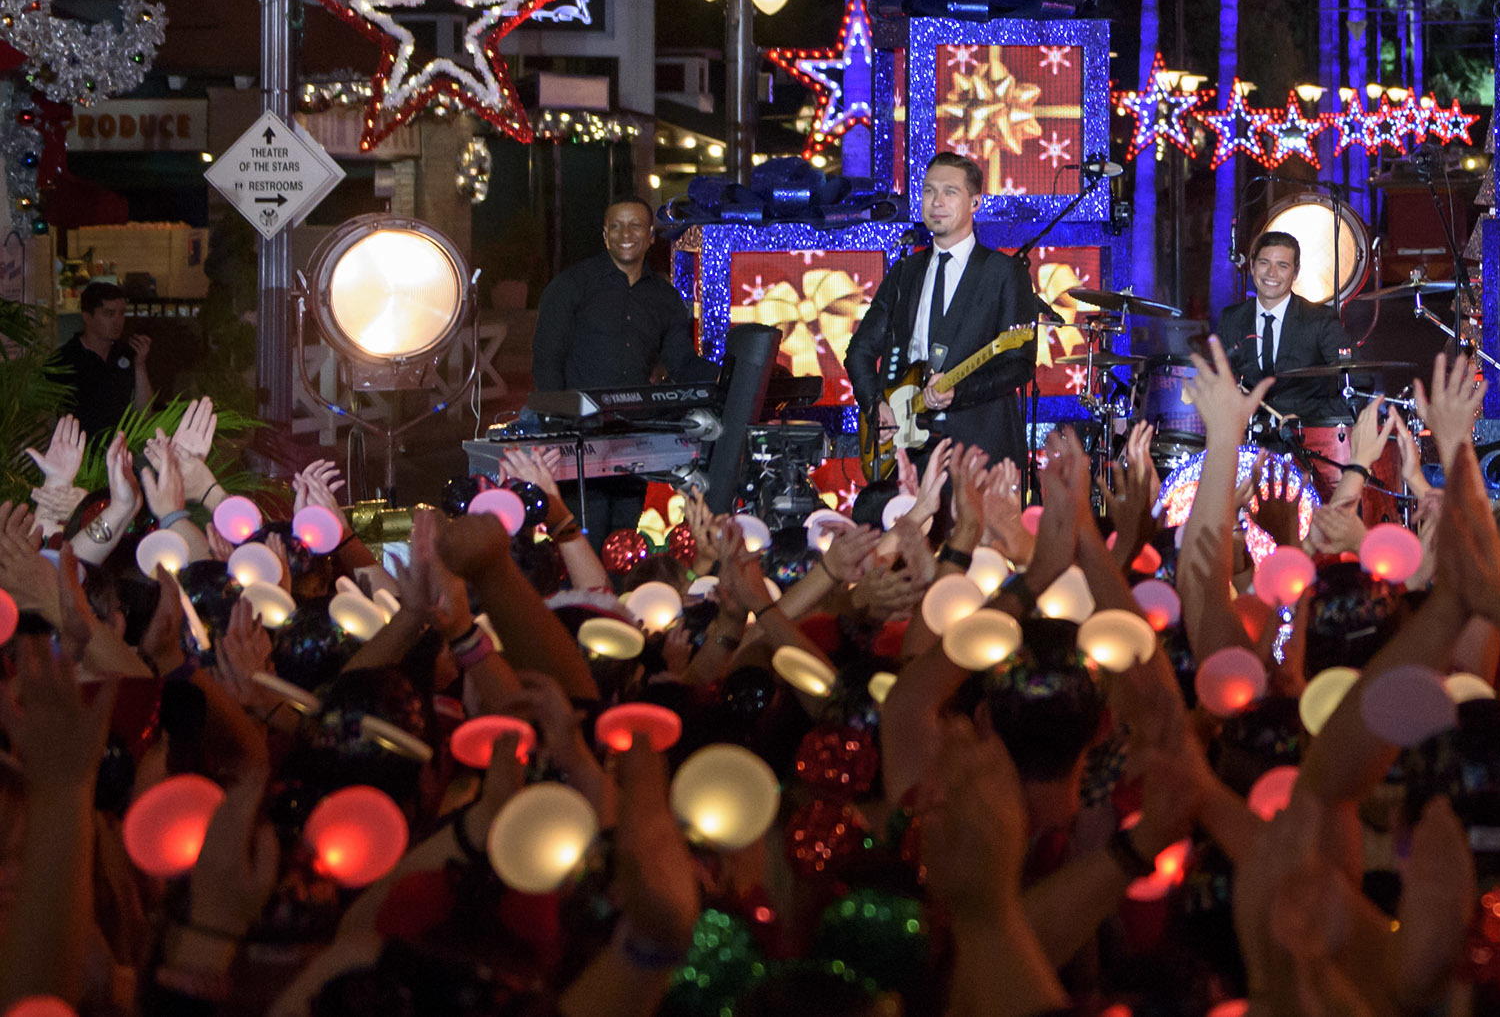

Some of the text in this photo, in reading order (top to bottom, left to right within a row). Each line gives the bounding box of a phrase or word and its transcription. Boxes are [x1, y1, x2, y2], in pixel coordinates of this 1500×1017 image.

[250, 147, 288, 158] THEATER
[239, 162, 300, 172] OF THE STARS
[248, 182, 304, 191] RESTROOMS
[611, 387, 643, 403] YAMAHA
